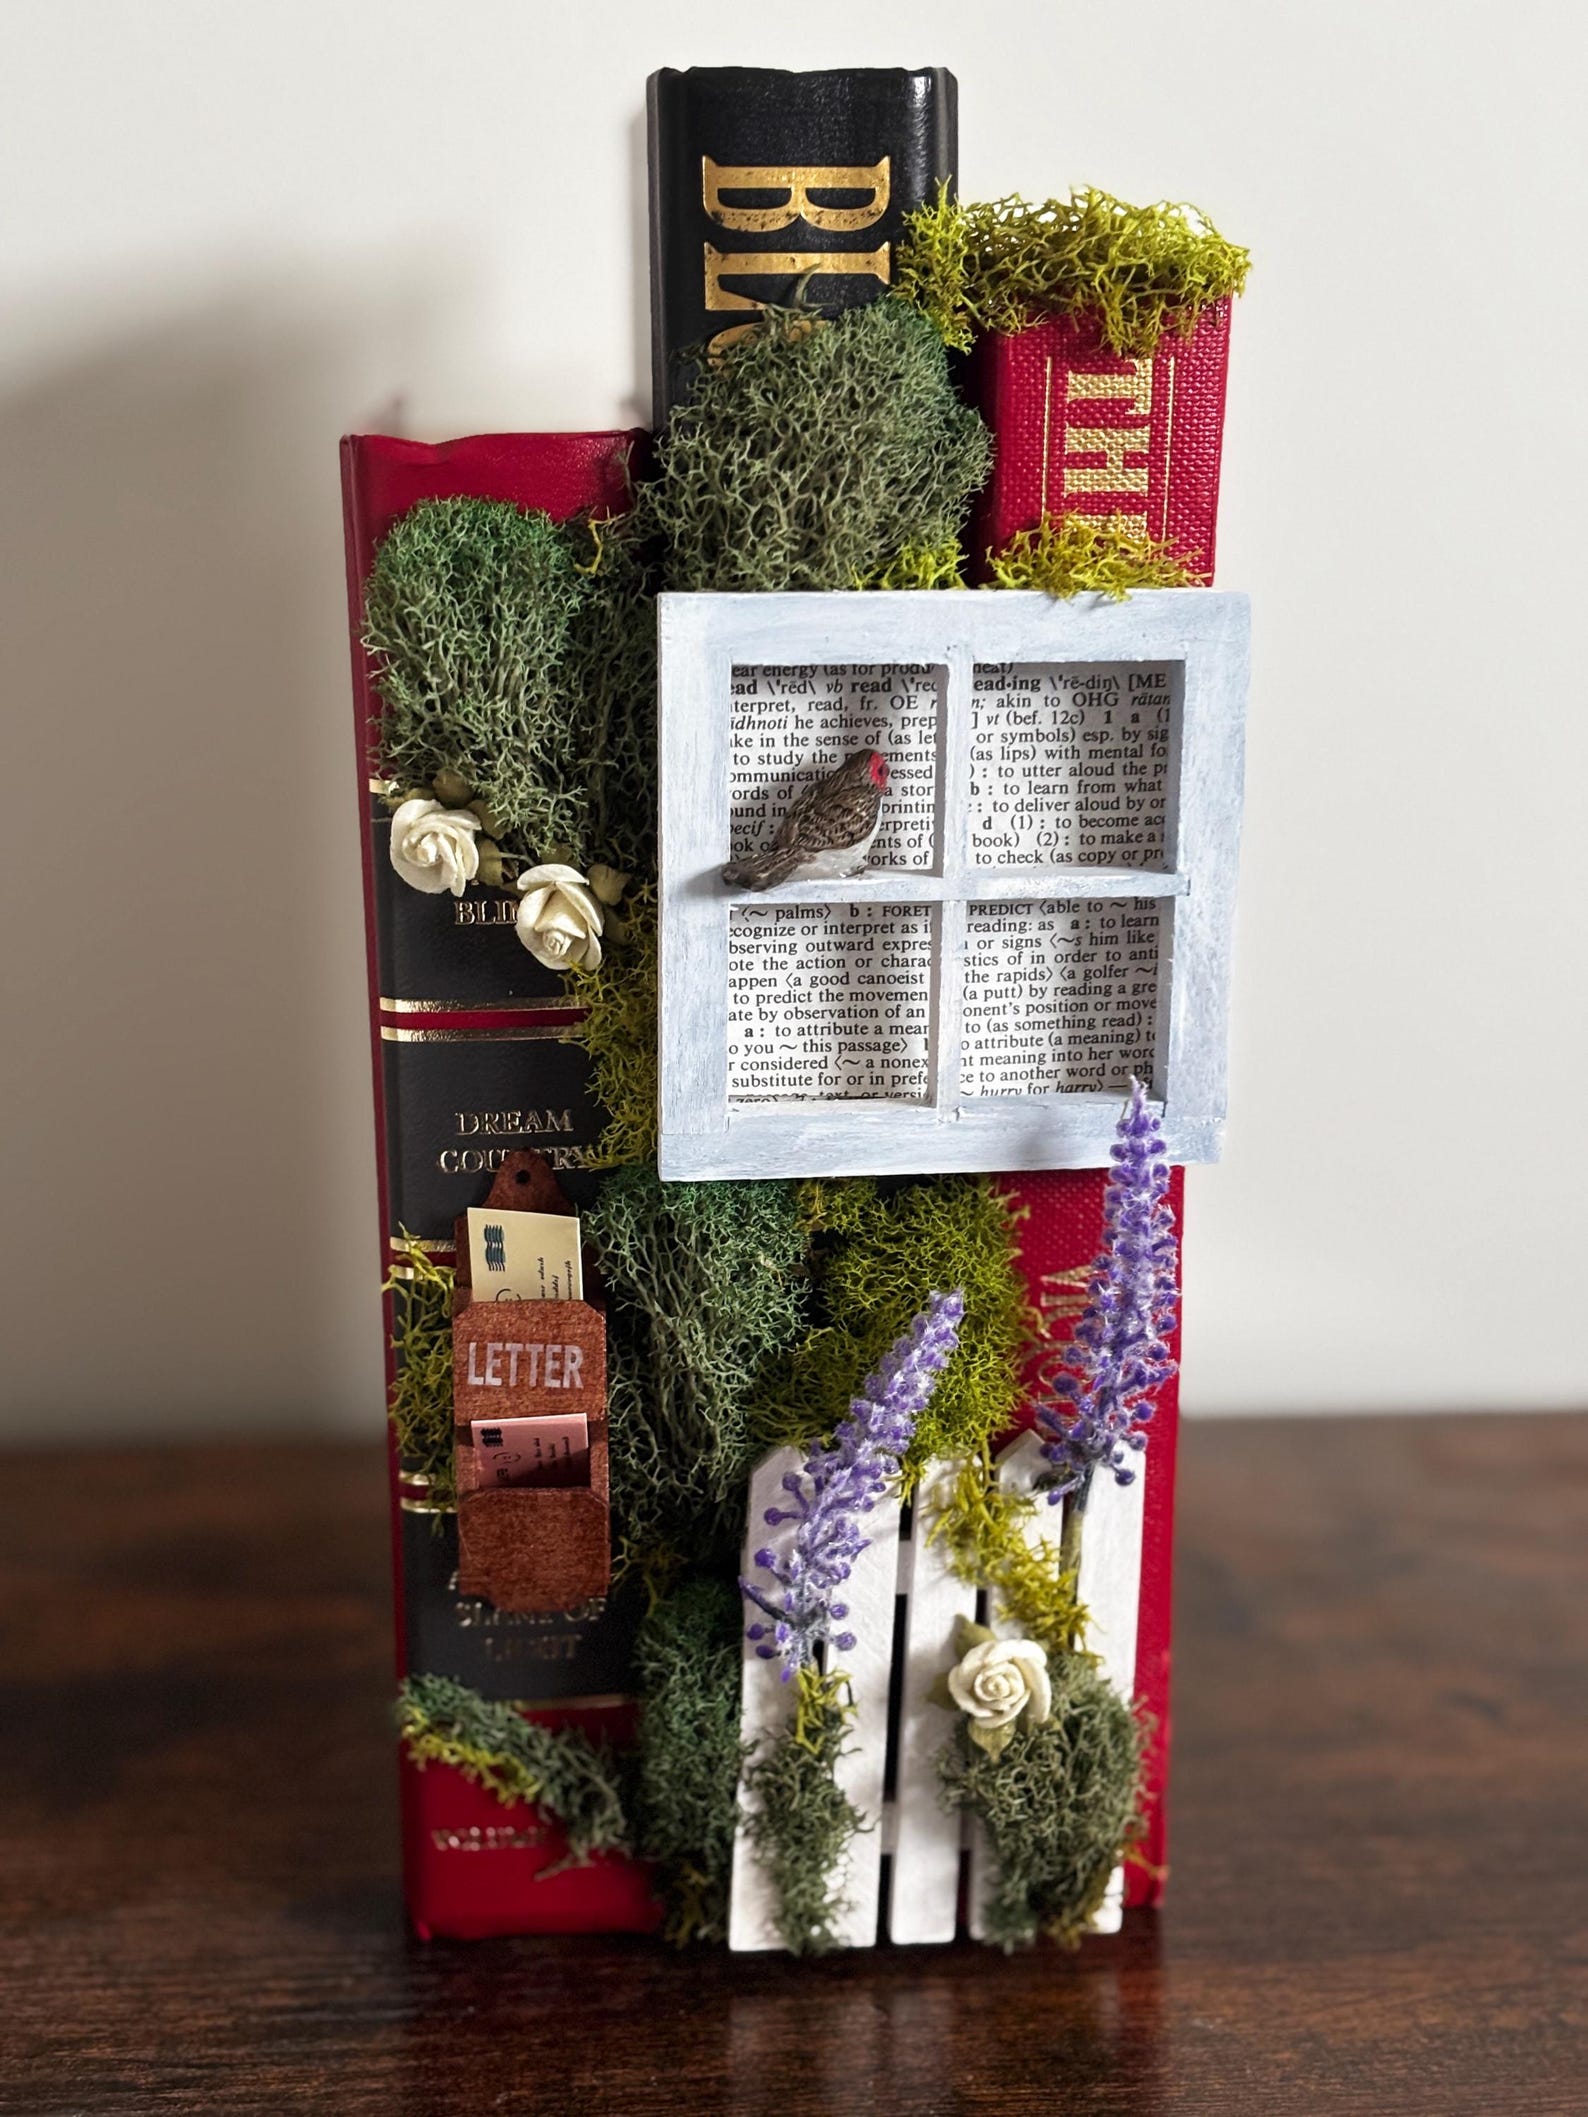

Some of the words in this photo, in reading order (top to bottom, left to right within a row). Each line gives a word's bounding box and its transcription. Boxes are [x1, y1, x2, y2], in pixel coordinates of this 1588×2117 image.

[826, 678, 844, 694] vb
[850, 678, 892, 694] read
[808, 697, 849, 712] read,
[860, 696, 878, 711] fr.
[889, 695, 918, 711] OE
[996, 693, 1031, 708] akin
[1044, 695, 1061, 708] to
[1072, 691, 1119, 707] OHG
[795, 714, 814, 729] he
[820, 713, 893, 729] achieves,
[1006, 710, 1042, 726] (bef.
[1052, 709, 1085, 726] 12c)
[760, 737, 775, 748] in
[783, 732, 809, 747] the
[815, 734, 859, 747] sense
[864, 731, 882, 746] of
[888, 730, 911, 746] (as
[976, 733, 994, 743] or
[1001, 727, 1076, 745] symbols)
[1121, 726, 1140, 743] by
[733, 753, 750, 766] to
[758, 750, 804, 767] study
[812, 749, 837, 765] the
[970, 746, 993, 761] (as
[1001, 745, 1036, 763] lips)
[1044, 744, 1080, 760] with
[1088, 743, 1143, 759] mental
[998, 766, 1014, 778] to
[1022, 765, 1062, 777] utter
[1068, 761, 1115, 777] aloud
[1122, 761, 1147, 776] the
[777, 785, 794, 800] of
[970, 781, 980, 796] b
[1004, 783, 1020, 795] to
[1028, 780, 1069, 795] learn
[1077, 779, 1116, 794] from
[1124, 777, 1162, 793] what
[772, 806, 787, 818] in
[993, 800, 1009, 813] to
[1014, 797, 1071, 813] deliver
[1074, 796, 1120, 811] aloud
[1126, 795, 1146, 812] by
[1149, 797, 1166, 809] or
[982, 816, 992, 830] d
[1010, 814, 1033, 830] (1)
[1055, 817, 1072, 829] to
[1078, 814, 1139, 829] become
[972, 832, 1020, 848] book)
[1036, 831, 1059, 847] (2)
[1079, 833, 1096, 846] to
[1100, 829, 1144, 845] make
[913, 851, 929, 865] of
[976, 853, 992, 864] to
[997, 849, 1044, 864] check
[1050, 848, 1073, 864] (as
[1078, 849, 1117, 864] copy
[1121, 850, 1139, 861] or
[849, 903, 859, 918] b
[968, 903, 1034, 916] PREDICT
[1088, 900, 1103, 913] to
[800, 925, 818, 936] or
[823, 920, 895, 937] interpret
[900, 923, 918, 934] as
[967, 918, 1032, 934] reading:
[1038, 920, 1054, 931] as
[1100, 917, 1116, 929] to
[1121, 913, 1160, 928] learn
[805, 938, 875, 953] outward
[977, 939, 994, 950] or
[1002, 935, 1042, 951] signs
[1088, 931, 1119, 946] him
[1126, 930, 1155, 944] like
[762, 956, 788, 971] the
[796, 957, 846, 970] action
[854, 957, 873, 968] or
[1007, 951, 1024, 965] of
[1031, 950, 1045, 964] in
[1054, 948, 1098, 964] order
[1105, 950, 1122, 962] to
[809, 971, 850, 989] good
[857, 973, 924, 985] canoeist
[965, 969, 989, 983] the
[1083, 965, 1130, 982] golfer
[733, 993, 750, 1004] to
[756, 989, 812, 1006] predict
[819, 988, 844, 1003] the
[963, 985, 978, 1001] (a
[984, 984, 1023, 1002] putt)
[1029, 984, 1048, 999] by
[1053, 982, 1113, 998] reading
[758, 1007, 778, 1023] by
[784, 1006, 879, 1020] observation
[884, 1004, 902, 1019] of
[906, 1008, 925, 1018] an
[1025, 1001, 1089, 1017] position
[1093, 1001, 1111, 1012] or
[775, 1025, 791, 1037] to
[797, 1022, 869, 1037] attribute
[965, 1022, 981, 1033] to
[987, 1018, 1009, 1033] (as
[1015, 1016, 1096, 1031] something
[1102, 1013, 1142, 1028] read)
[744, 1044, 774, 1057] you
[803, 1038, 832, 1053] this
[975, 1035, 1044, 1049] attribute
[1048, 1032, 1063, 1047] (a
[1067, 1030, 1141, 1046] meaning)
[740, 1056, 828, 1071] considered
[980, 1053, 1046, 1066] meaning
[1052, 1048, 1083, 1062] into
[1087, 1046, 1114, 1061] her
[732, 1074, 813, 1088] substitute
[818, 1071, 842, 1086] for
[846, 1075, 865, 1086] or
[869, 1075, 885, 1086] in
[980, 1072, 995, 1082] to
[1000, 1066, 1061, 1081] another
[1065, 1064, 1106, 1078] word
[1111, 1065, 1129, 1076] or
[1027, 1082, 1050, 1095] for
[454, 1108, 574, 1136] DREAM
[466, 1342, 584, 1389] LETTER
